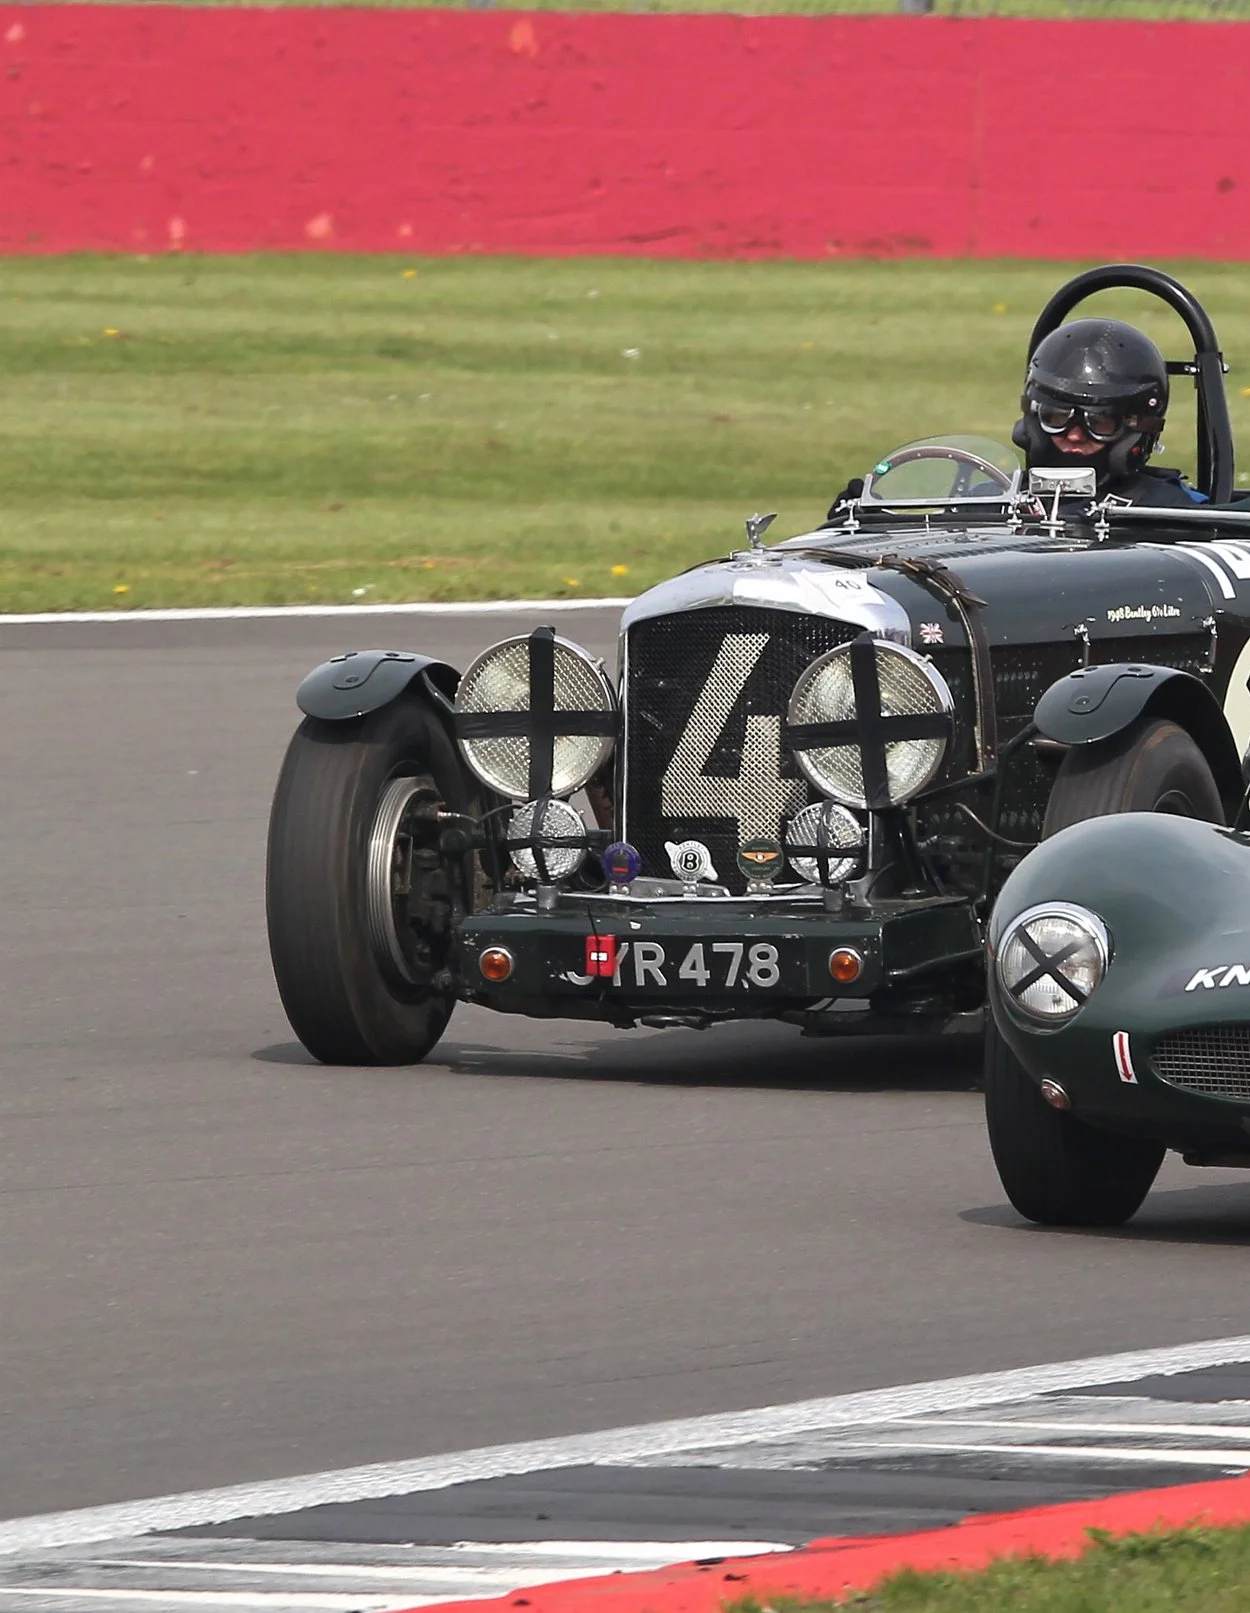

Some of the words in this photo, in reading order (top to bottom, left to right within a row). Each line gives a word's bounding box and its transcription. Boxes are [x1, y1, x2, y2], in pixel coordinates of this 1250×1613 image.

[1124, 604, 1152, 622] Bentley
[662, 633, 807, 847] 4
[567, 942, 667, 986] YR
[679, 942, 780, 987] 478
